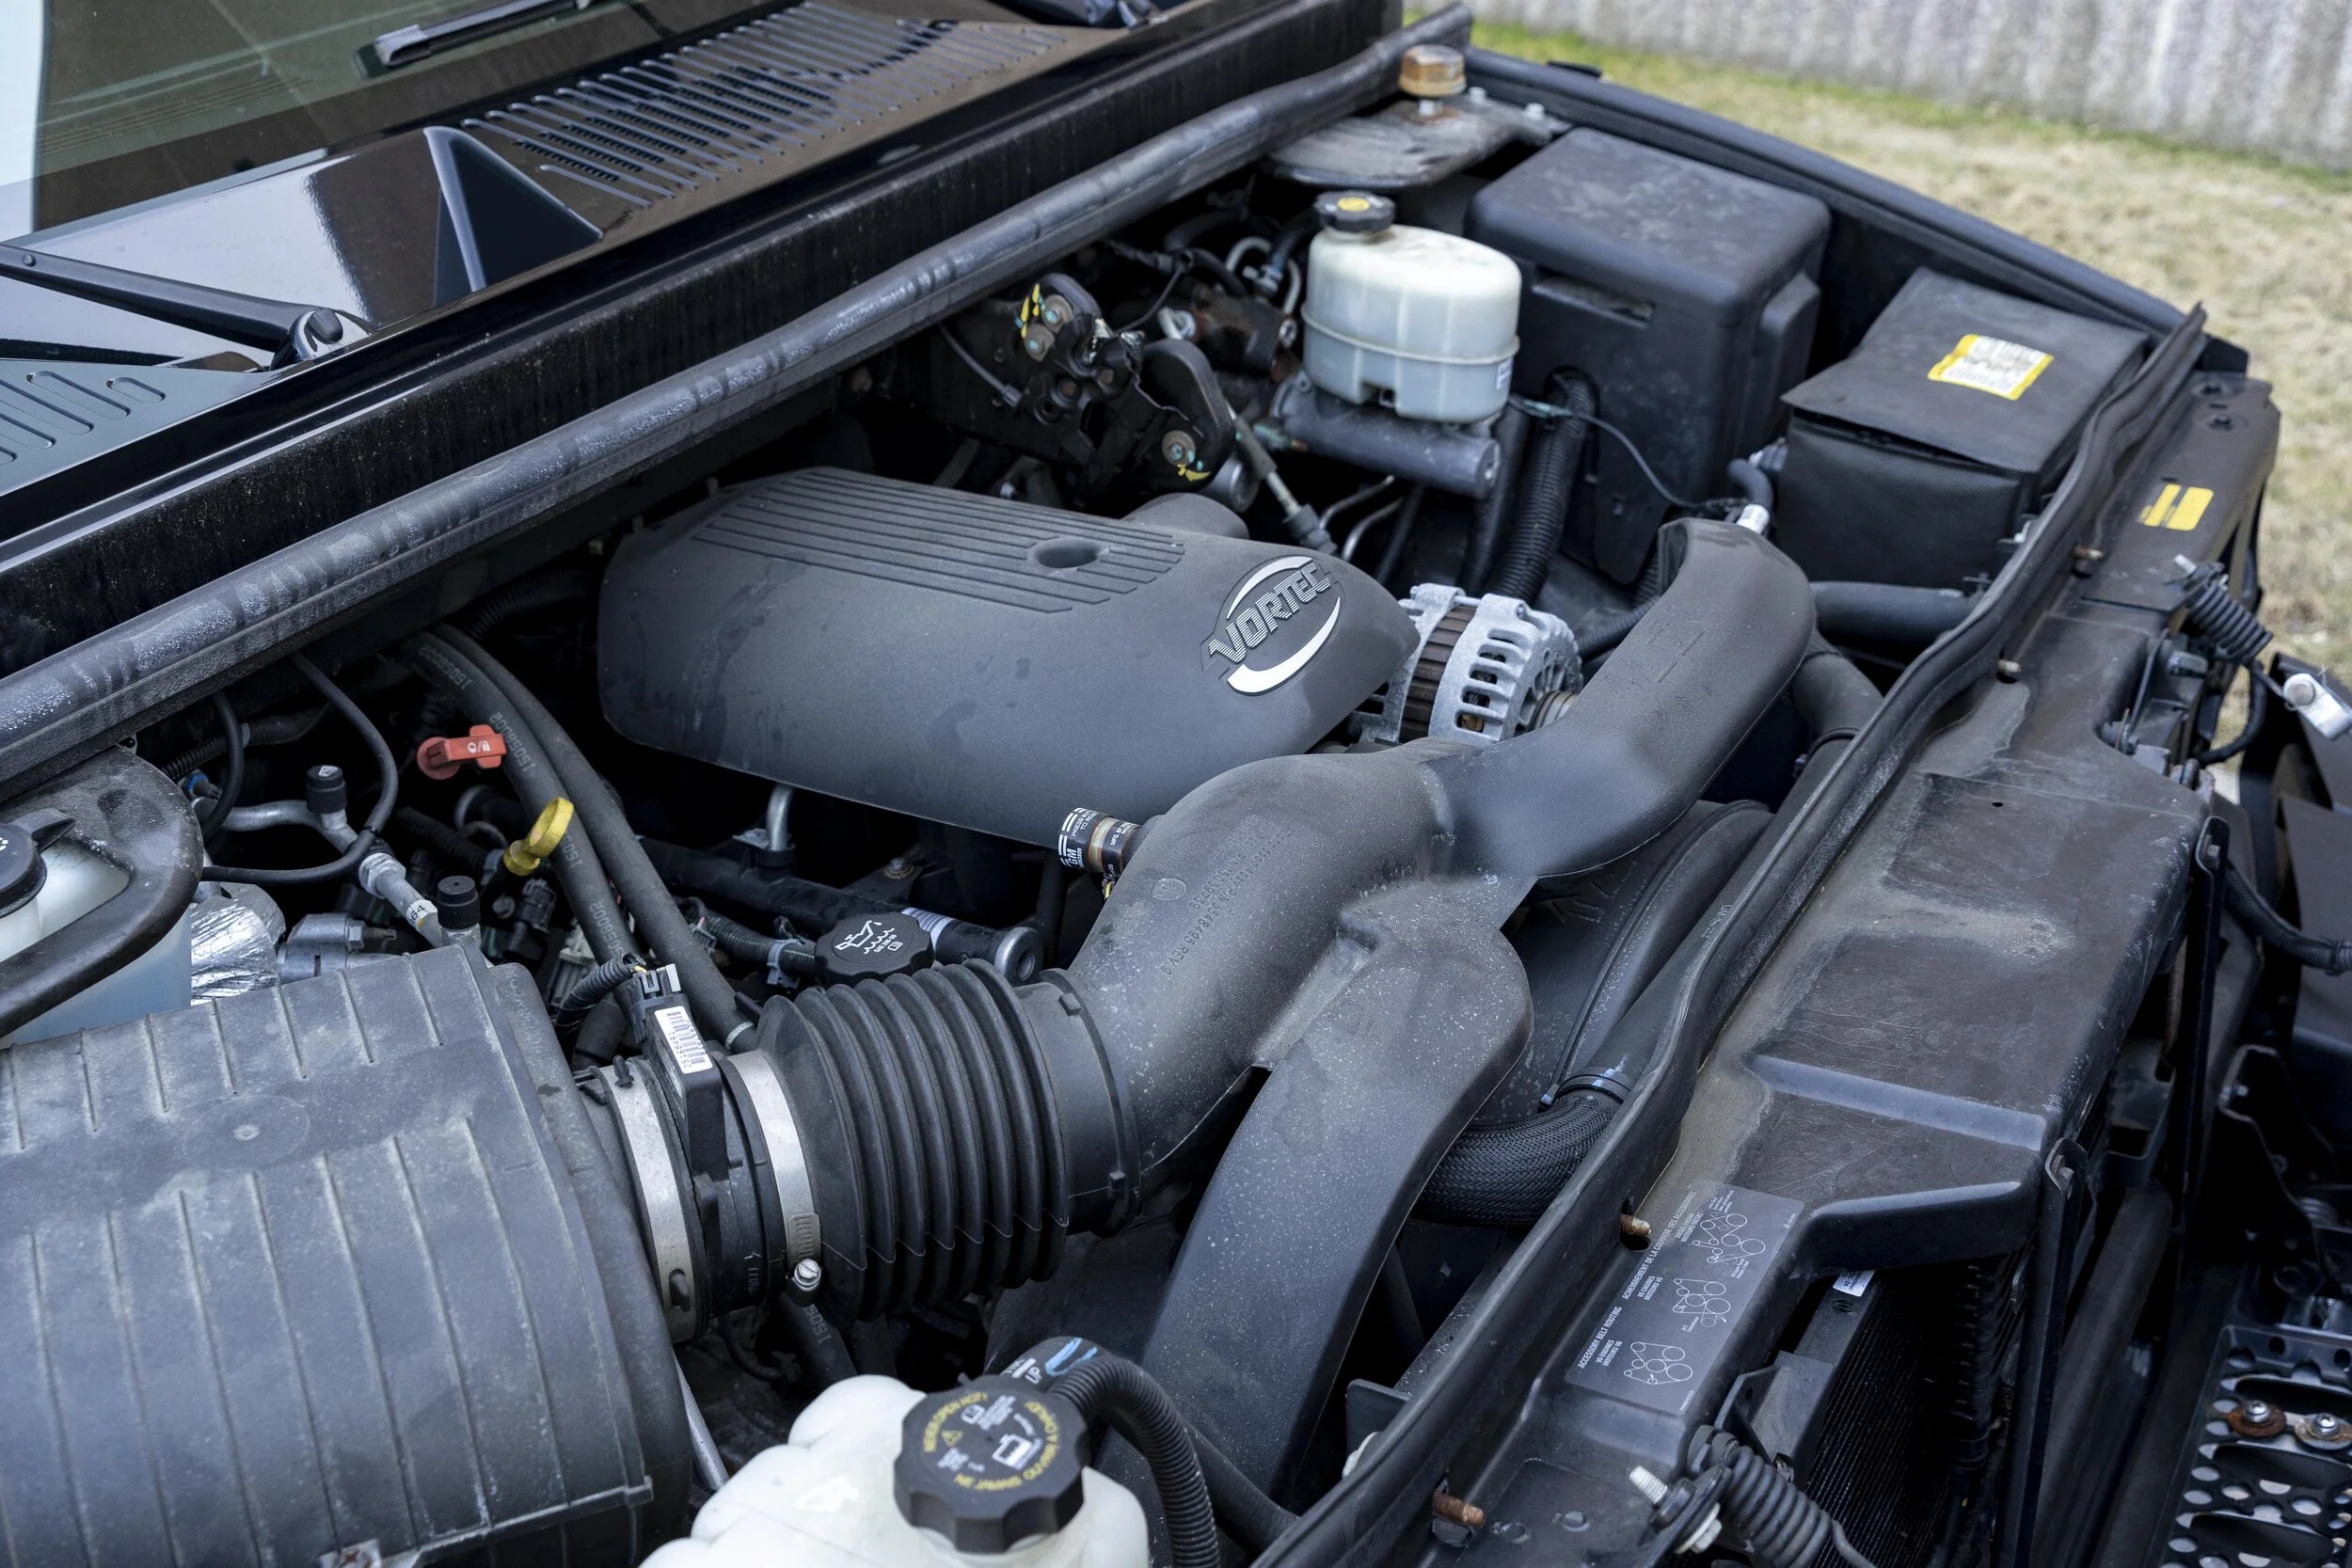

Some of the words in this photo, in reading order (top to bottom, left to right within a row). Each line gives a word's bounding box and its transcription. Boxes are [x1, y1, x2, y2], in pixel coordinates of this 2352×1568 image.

[1208, 562, 1331, 664] VORTEC
[1080, 820, 1089, 830] TO
[1066, 847, 1079, 864] GM
[1166, 943, 1188, 966] REV
[1645, 1254, 1654, 1264] DE
[1651, 1245, 1659, 1256] LA
[1578, 1338, 1600, 1369] ACCESSORY
[1596, 1325, 1608, 1340] BELT
[1603, 1306, 1623, 1327] ROUTING
[1600, 1339, 1615, 1356] ENGINES
[1025, 1366, 1042, 1385] UP
[954, 1472, 976, 1489] NE
